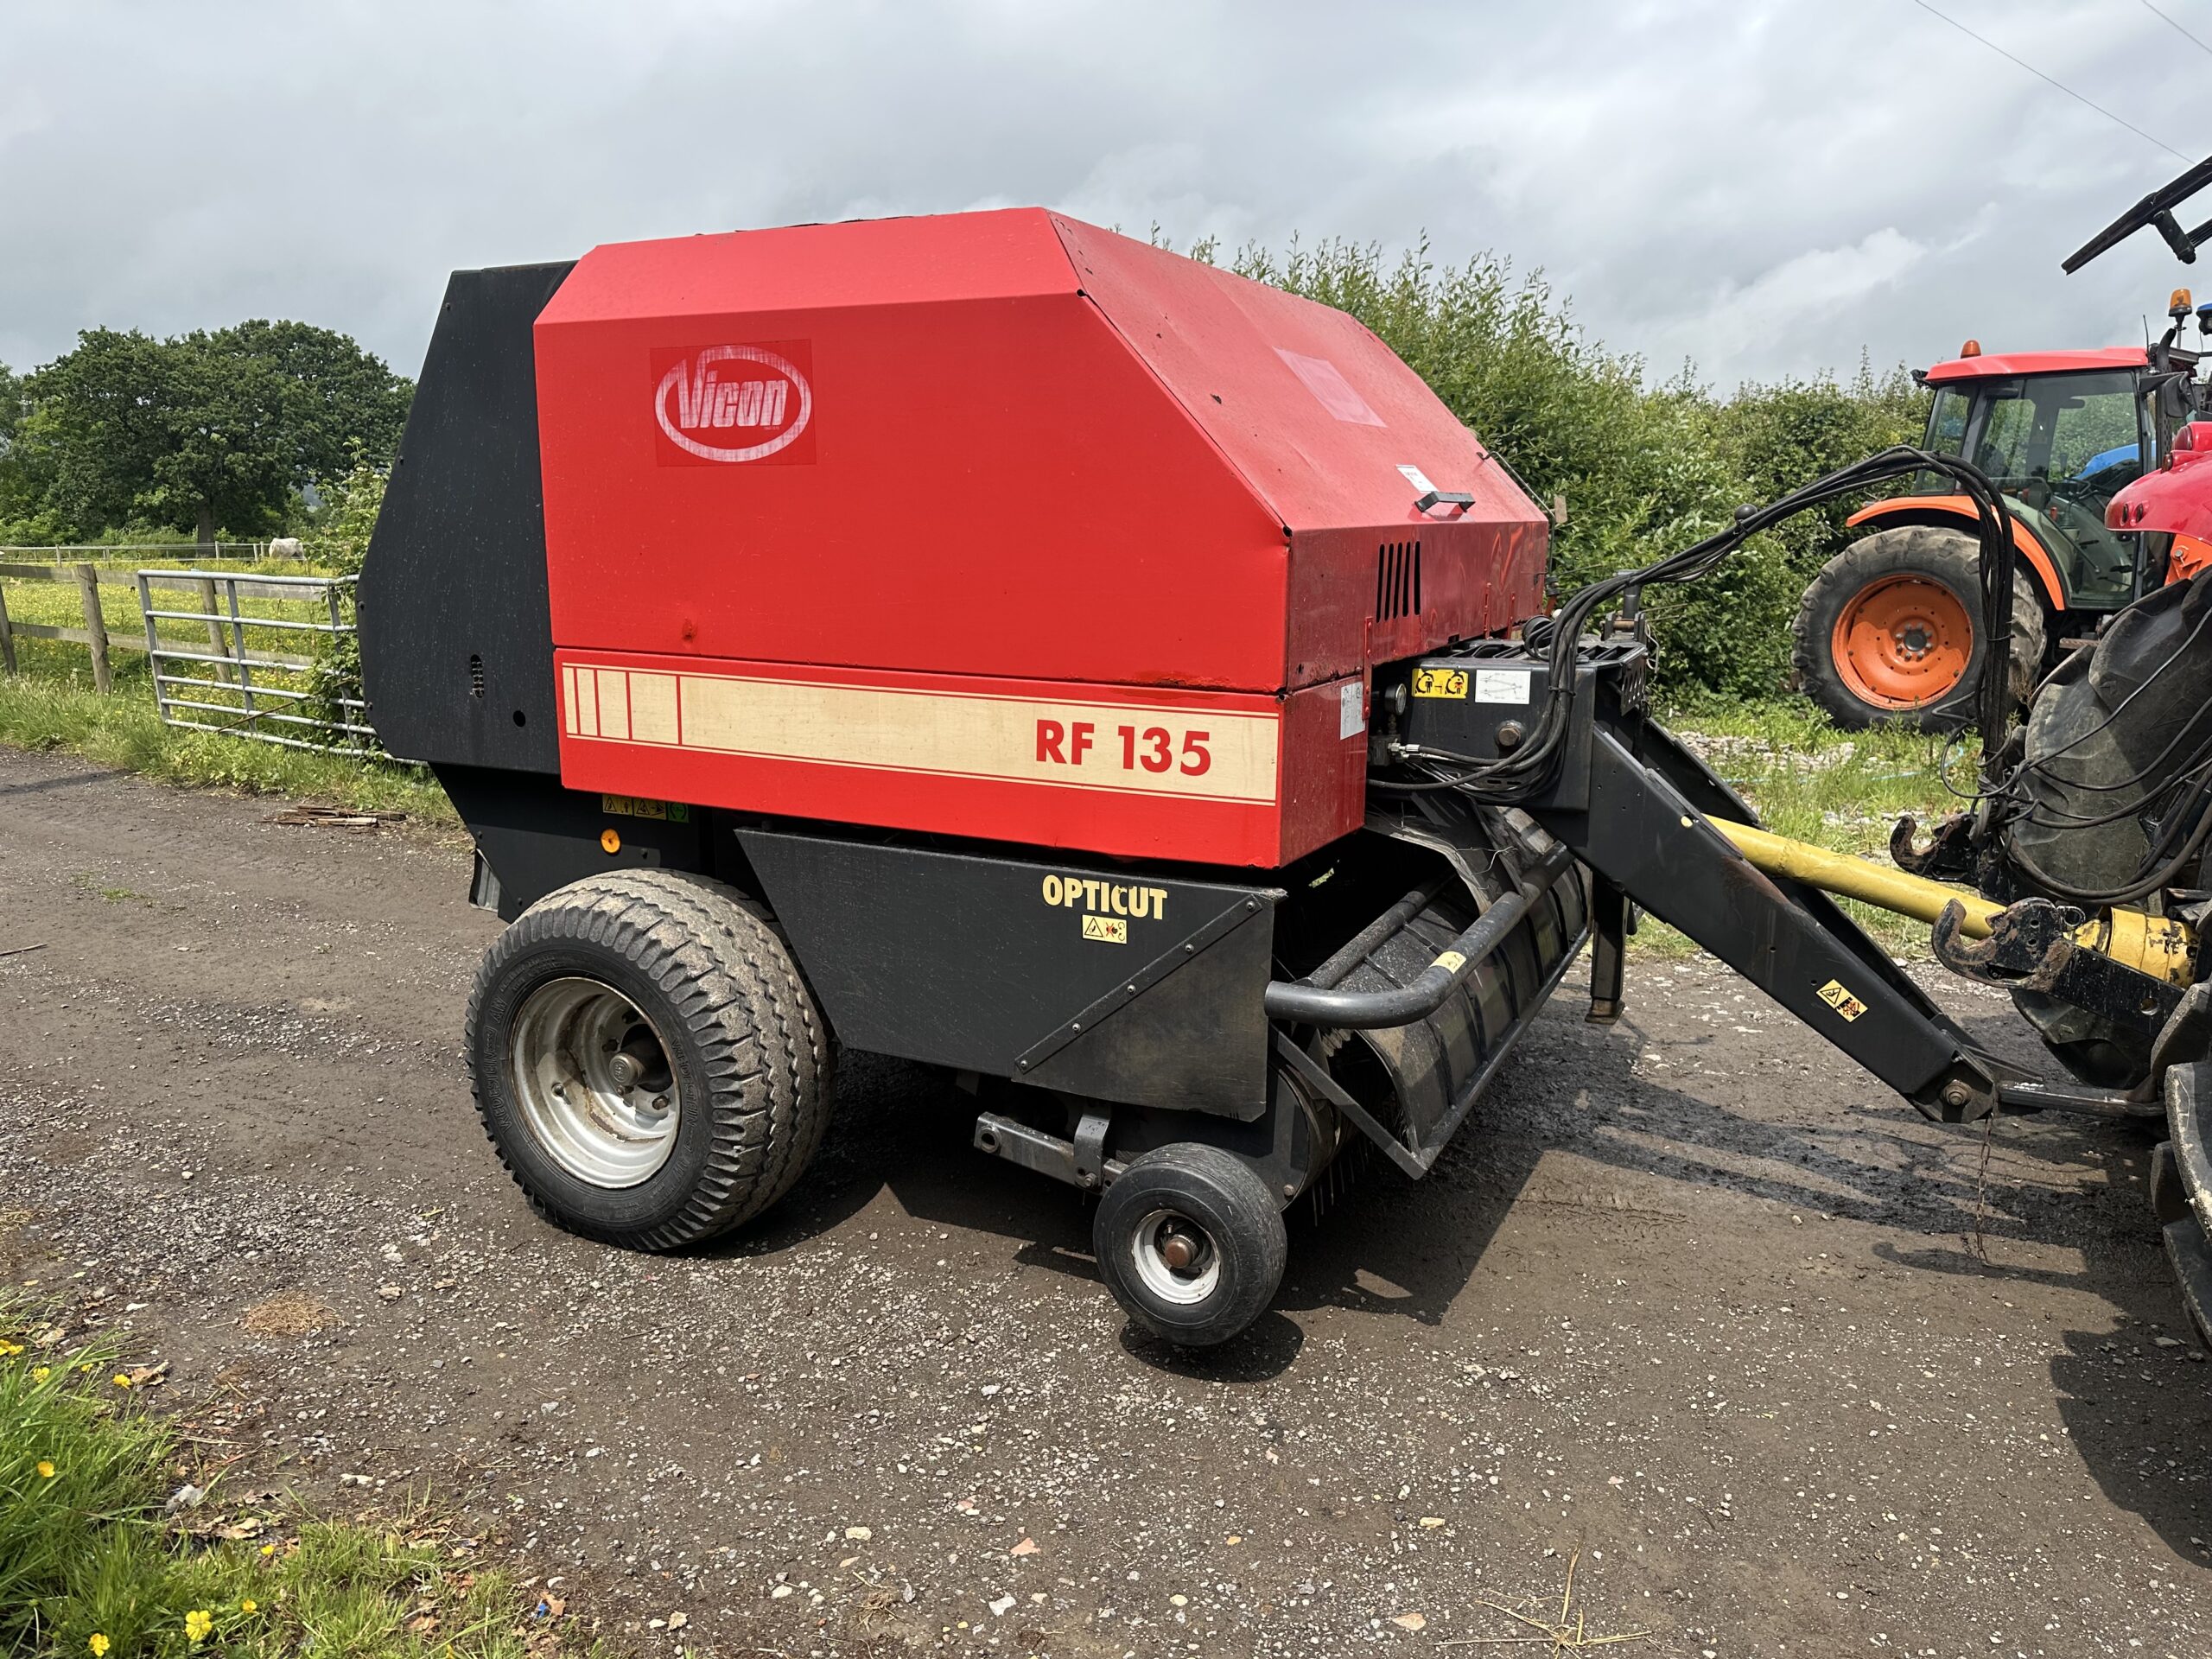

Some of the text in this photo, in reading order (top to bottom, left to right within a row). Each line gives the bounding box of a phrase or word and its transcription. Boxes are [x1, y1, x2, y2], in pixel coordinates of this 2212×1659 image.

[677, 351, 788, 429] Vicon
[1036, 719, 1211, 776] RF 135
[1042, 874, 1168, 920] OPTICUT
